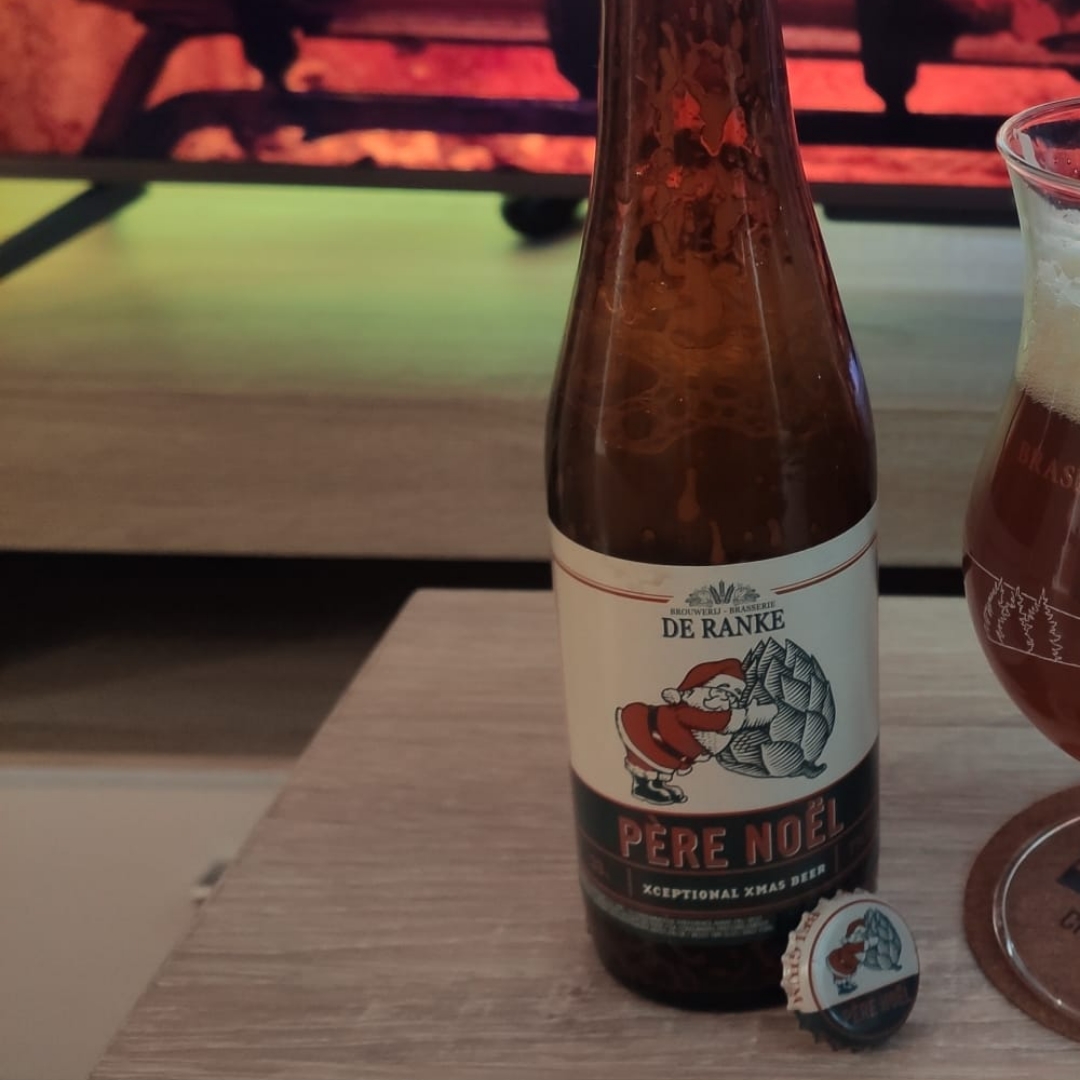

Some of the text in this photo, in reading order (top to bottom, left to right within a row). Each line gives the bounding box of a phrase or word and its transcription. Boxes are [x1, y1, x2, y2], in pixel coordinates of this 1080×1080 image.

[661, 608, 786, 639] DE RANKE
[669, 606, 722, 616] BROUWERIJ
[729, 600, 776, 615] BRASSERIE
[617, 814, 729, 869] PÈRE
[744, 796, 845, 866] NOËL
[642, 863, 826, 900] XCEPTIONAL XMAS BEER
